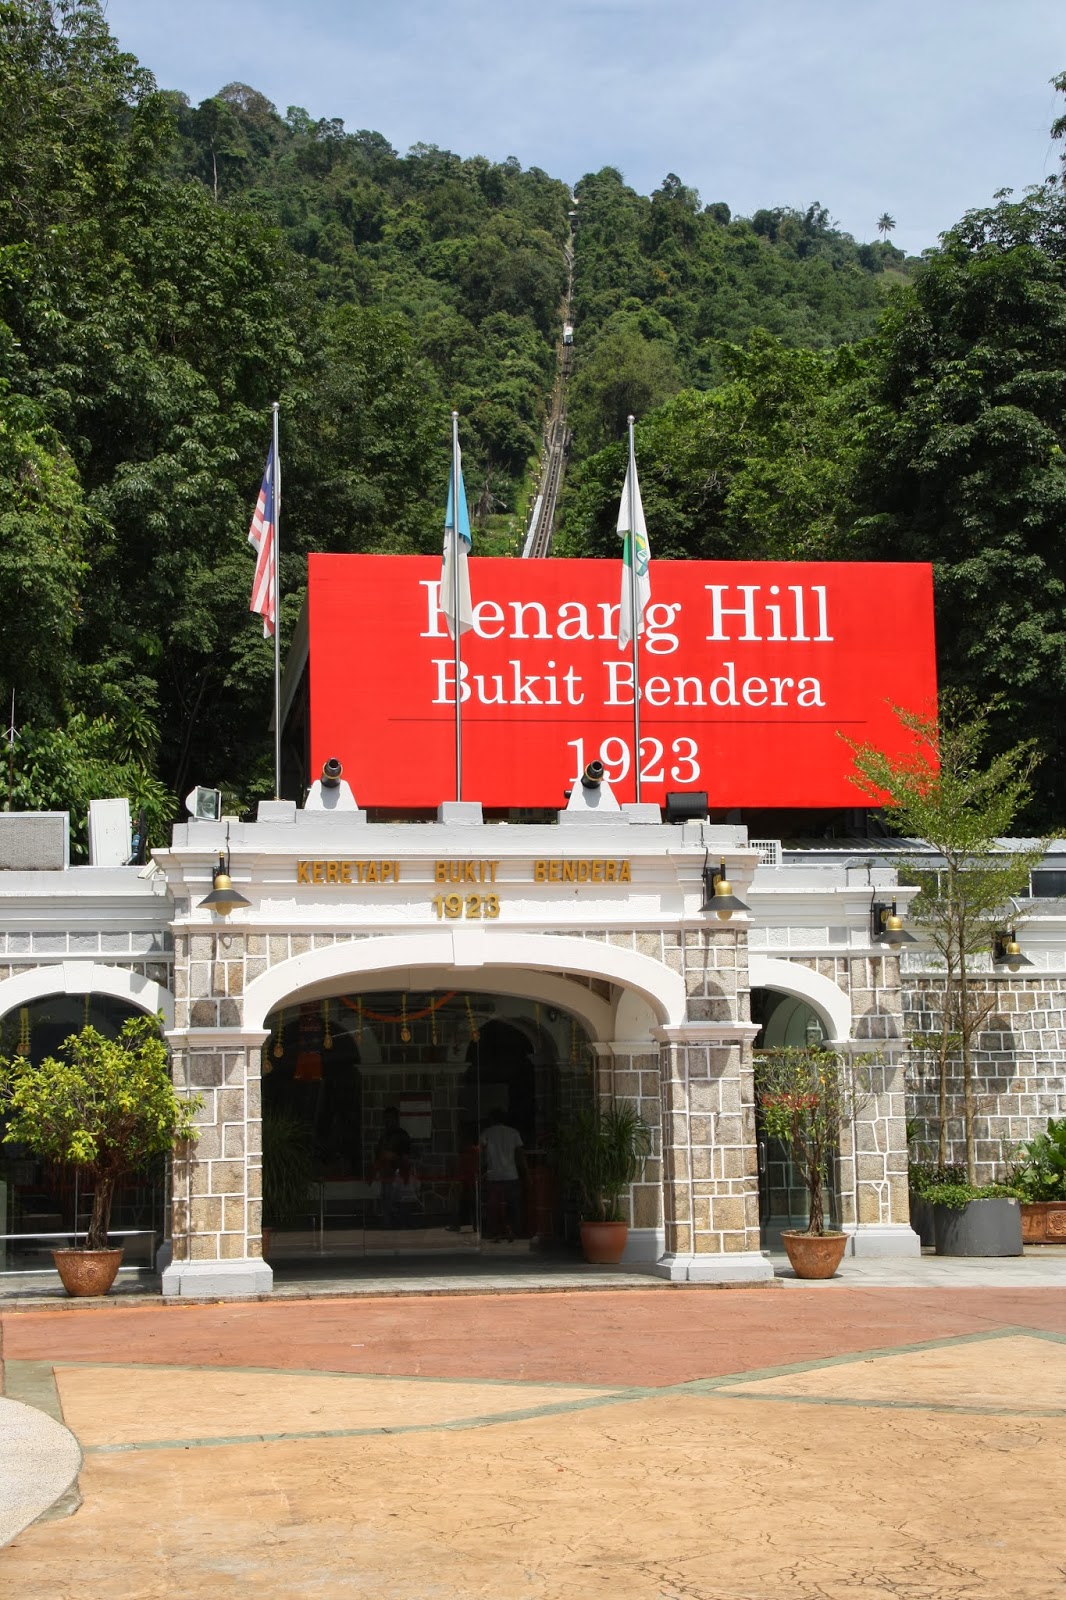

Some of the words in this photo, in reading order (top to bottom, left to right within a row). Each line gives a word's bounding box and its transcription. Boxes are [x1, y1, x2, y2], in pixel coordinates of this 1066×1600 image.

[705, 585, 834, 644] Hill
[432, 659, 584, 705] Bukit
[603, 661, 826, 707] Bendera
[567, 737, 701, 783] 1923
[297, 860, 400, 884] KERETAPI
[435, 860, 500, 884] BUKIT
[534, 859, 632, 883] BENDERA
[433, 893, 500, 919] 1923
